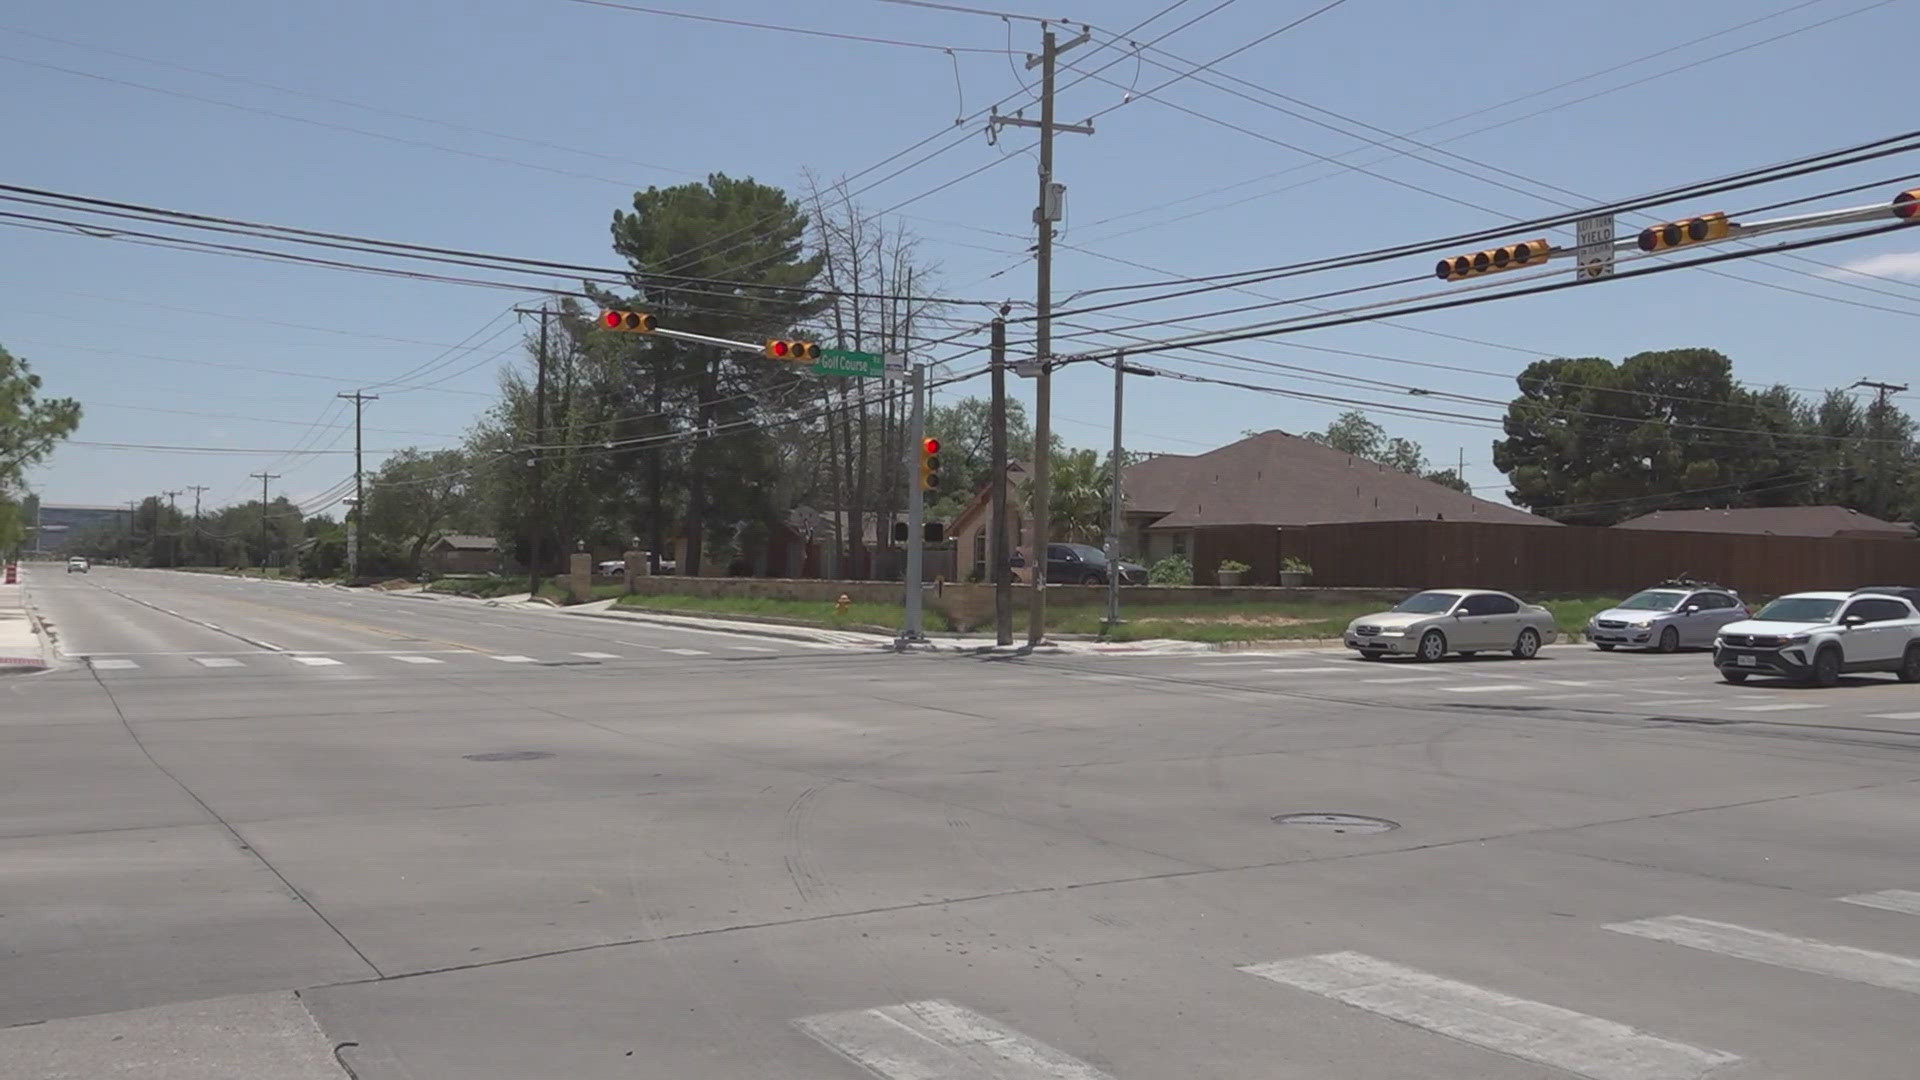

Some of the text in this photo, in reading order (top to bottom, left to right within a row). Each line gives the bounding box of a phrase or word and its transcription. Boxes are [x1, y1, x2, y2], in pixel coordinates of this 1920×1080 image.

[1581, 229, 1611, 243] YIELD
[822, 354, 839, 369] Golf
[839, 356, 868, 372] Course
